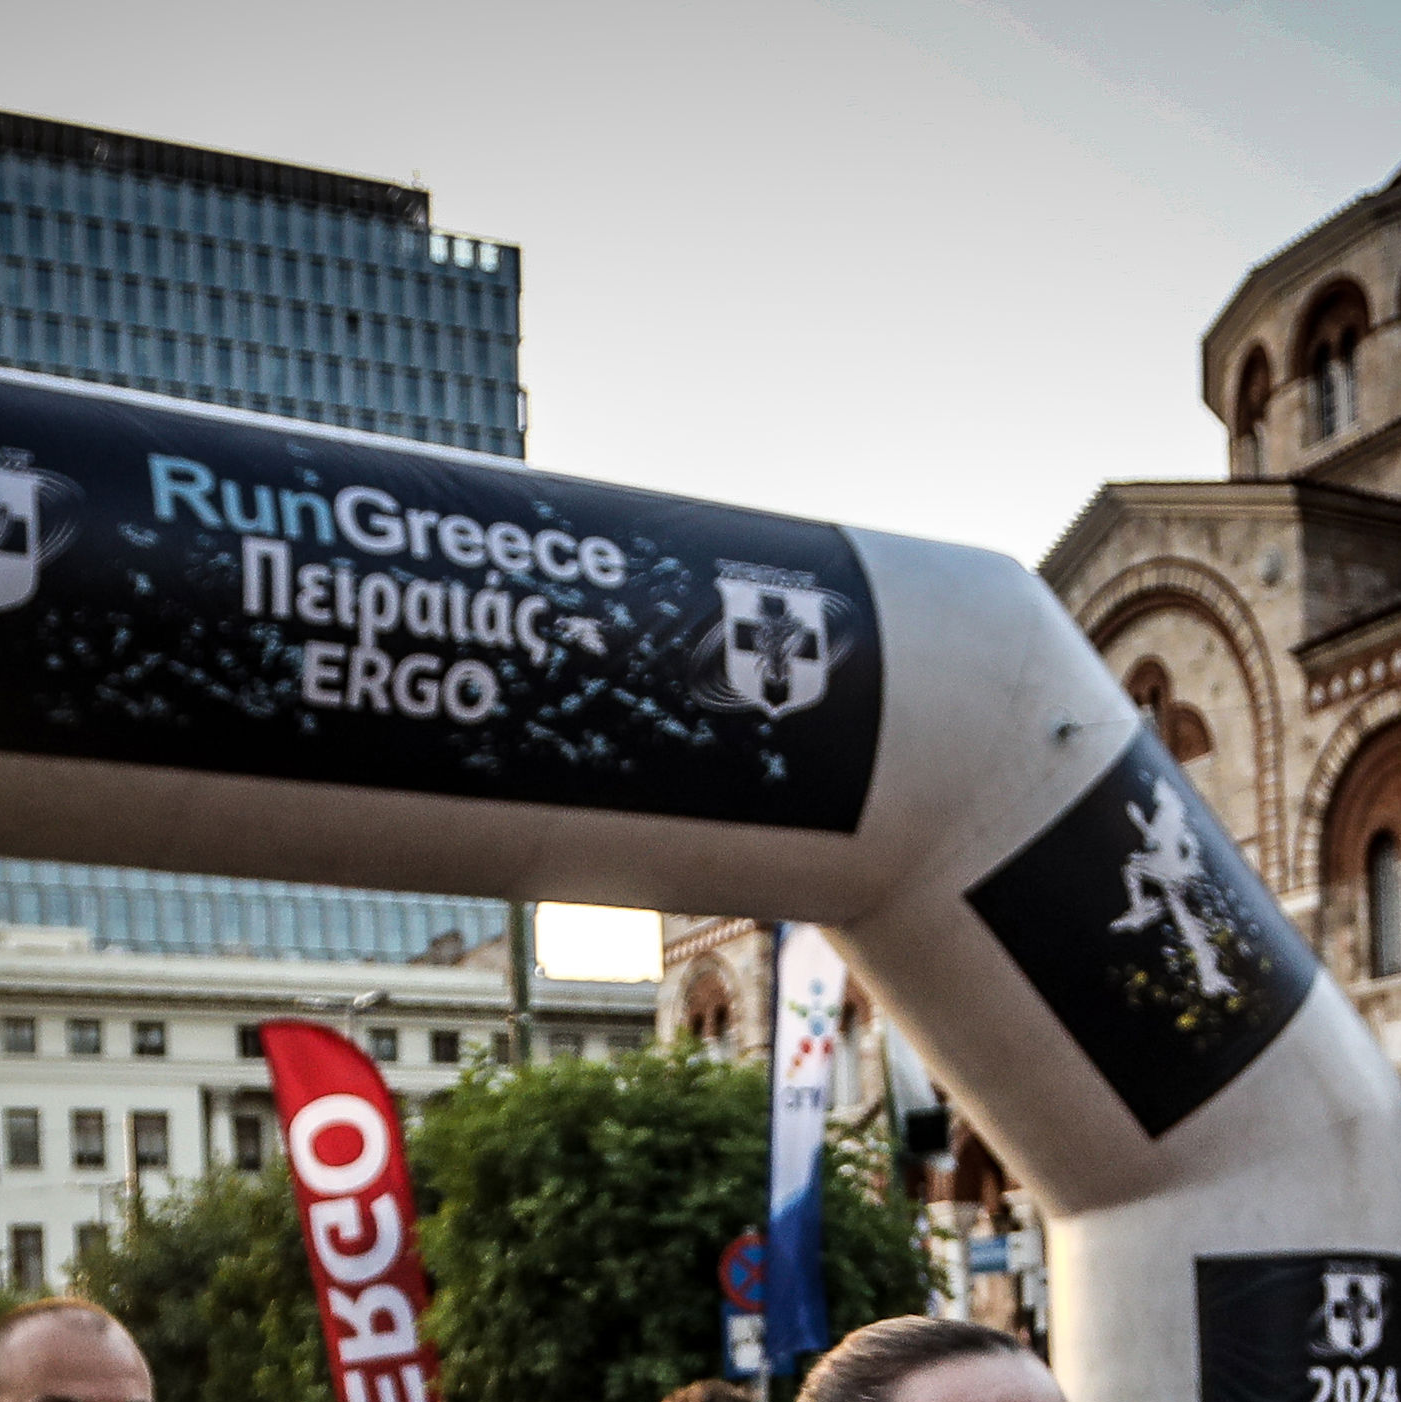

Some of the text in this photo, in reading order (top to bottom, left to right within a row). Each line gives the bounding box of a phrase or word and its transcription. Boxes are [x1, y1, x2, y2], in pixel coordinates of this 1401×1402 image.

[147, 452, 628, 590] RunGreece
[241, 534, 550, 668] Πειραιάς
[301, 638, 498, 725] ERGO
